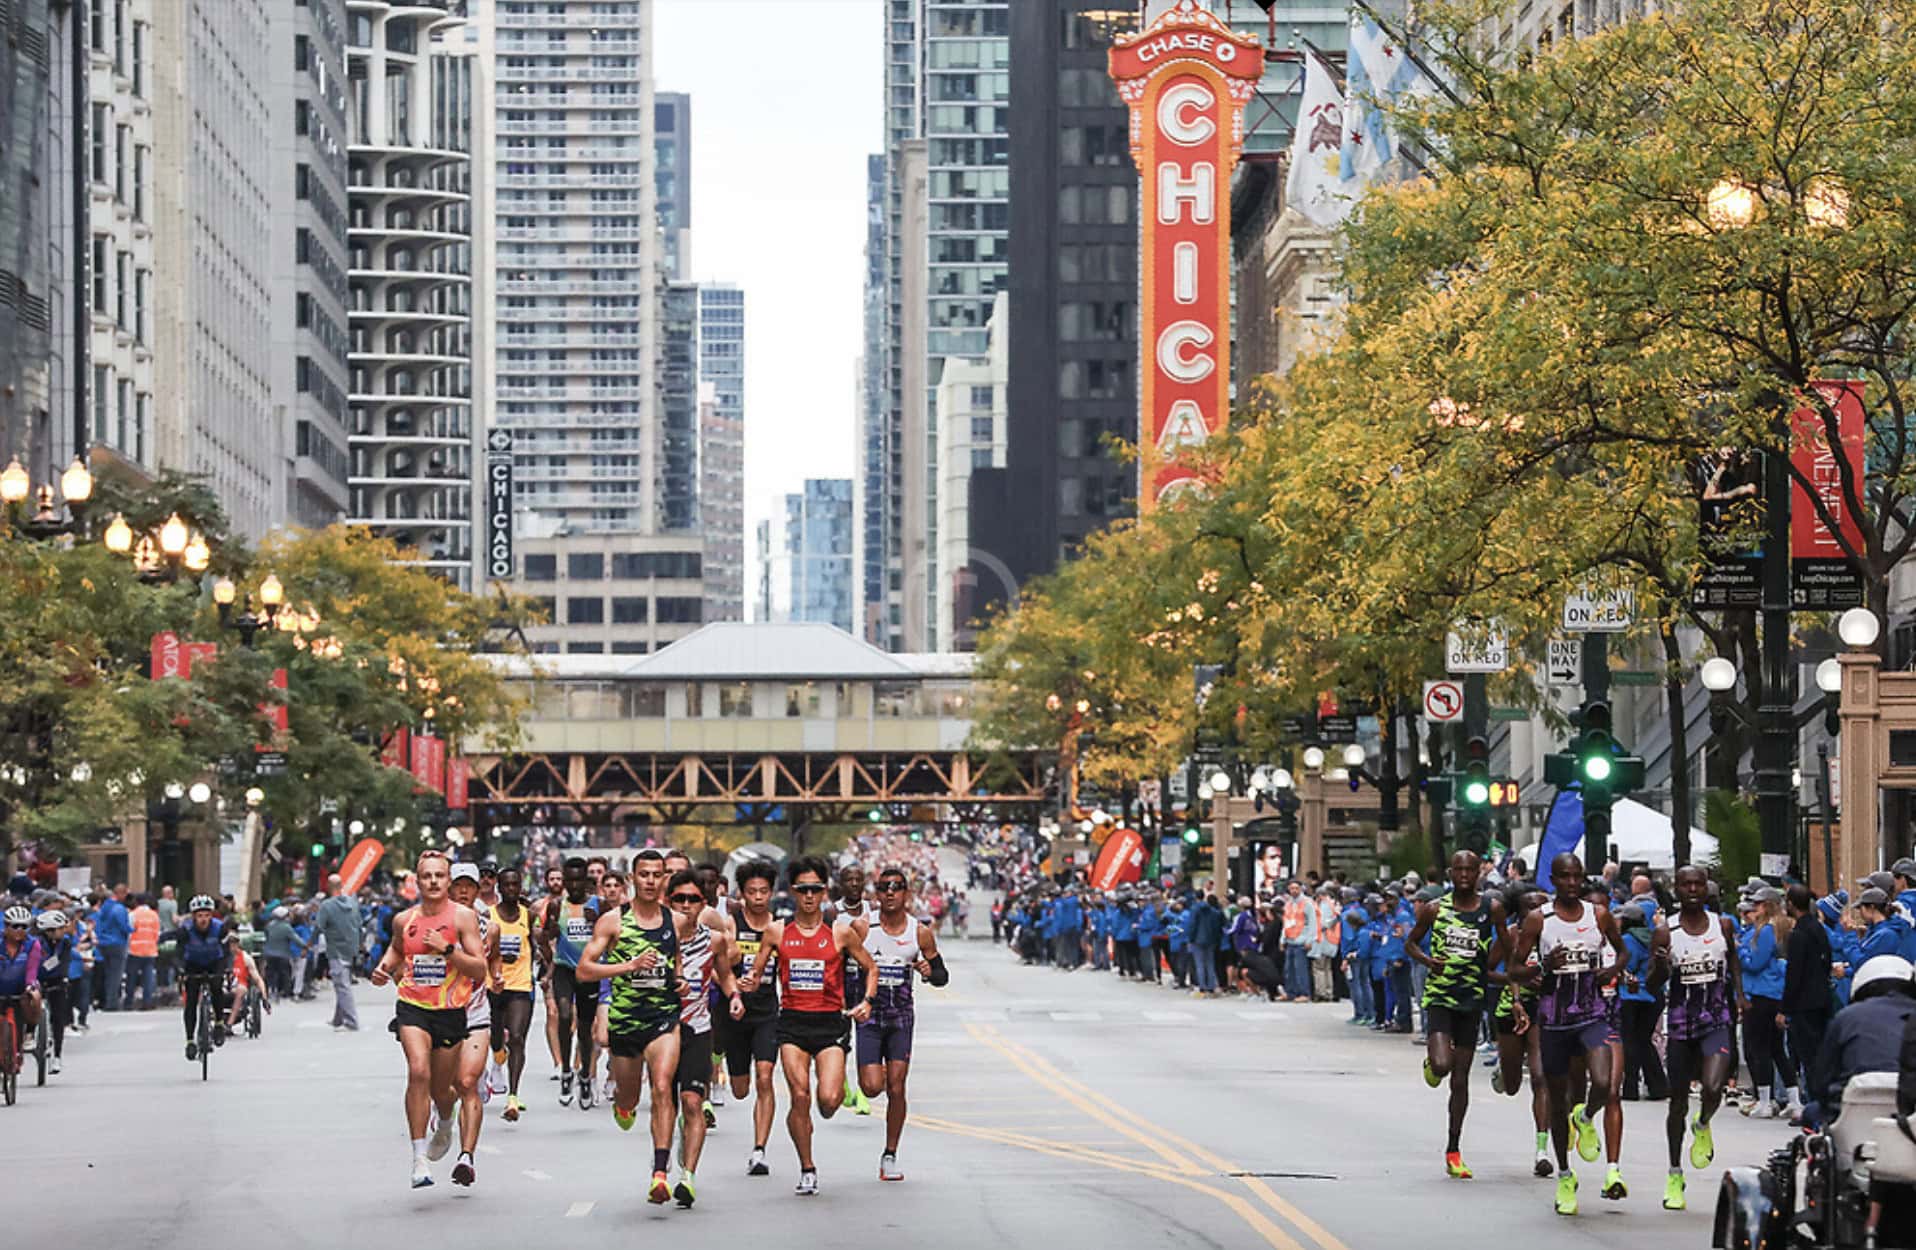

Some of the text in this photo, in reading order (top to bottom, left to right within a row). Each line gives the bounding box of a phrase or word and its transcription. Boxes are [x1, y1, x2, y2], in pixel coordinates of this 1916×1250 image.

[1137, 34, 1215, 62] CHASE
[1157, 83, 1216, 503] CHICA
[492, 465, 509, 576] CHICAGO
[1568, 608, 1590, 622] ON
[1551, 643, 1577, 654] ONE
[1452, 652, 1502, 664] ON RED
[1551, 655, 1578, 666] WAY
[1680, 963, 1703, 974] PACE
